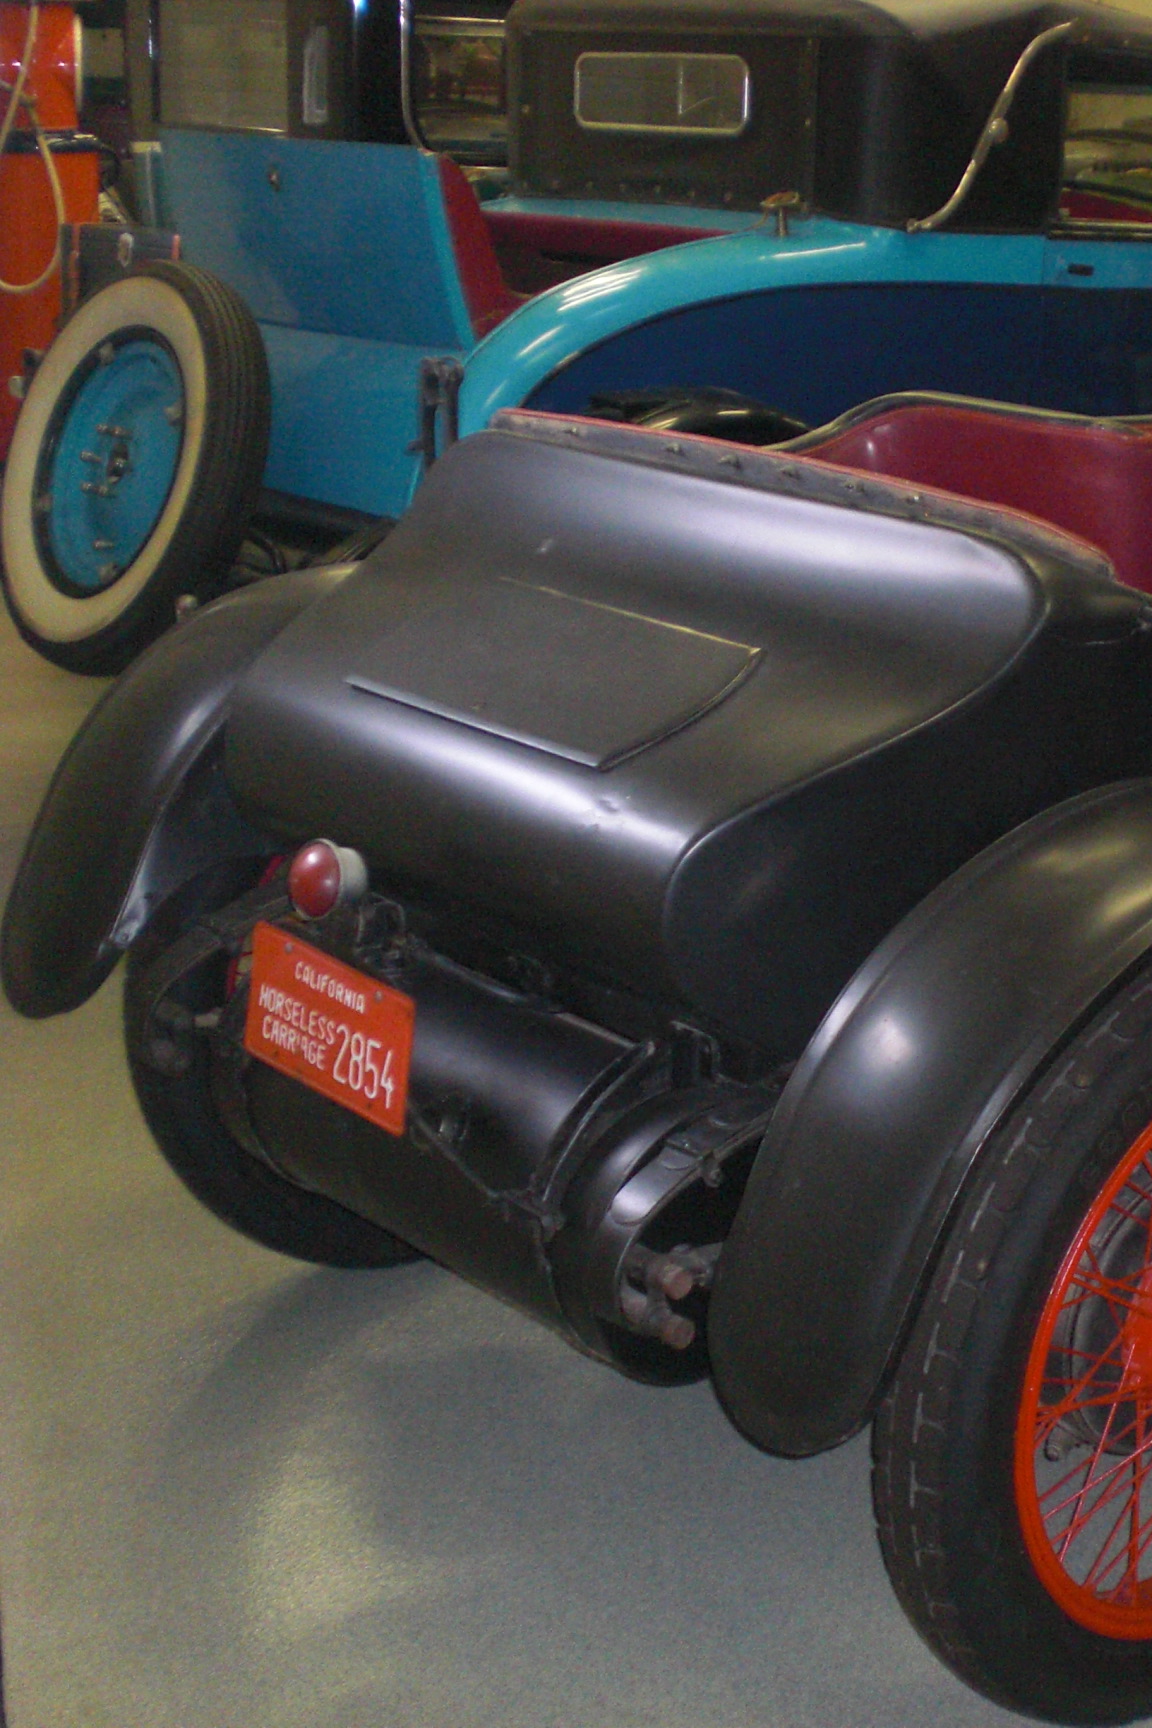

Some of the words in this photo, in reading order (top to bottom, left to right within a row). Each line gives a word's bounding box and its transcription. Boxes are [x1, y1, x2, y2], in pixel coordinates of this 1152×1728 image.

[259, 984, 335, 1045] HORSELESS
[294, 961, 366, 1014] CALIFORNIA
[262, 1015, 326, 1070] CARRIAGE
[333, 1024, 394, 1109] 2854
